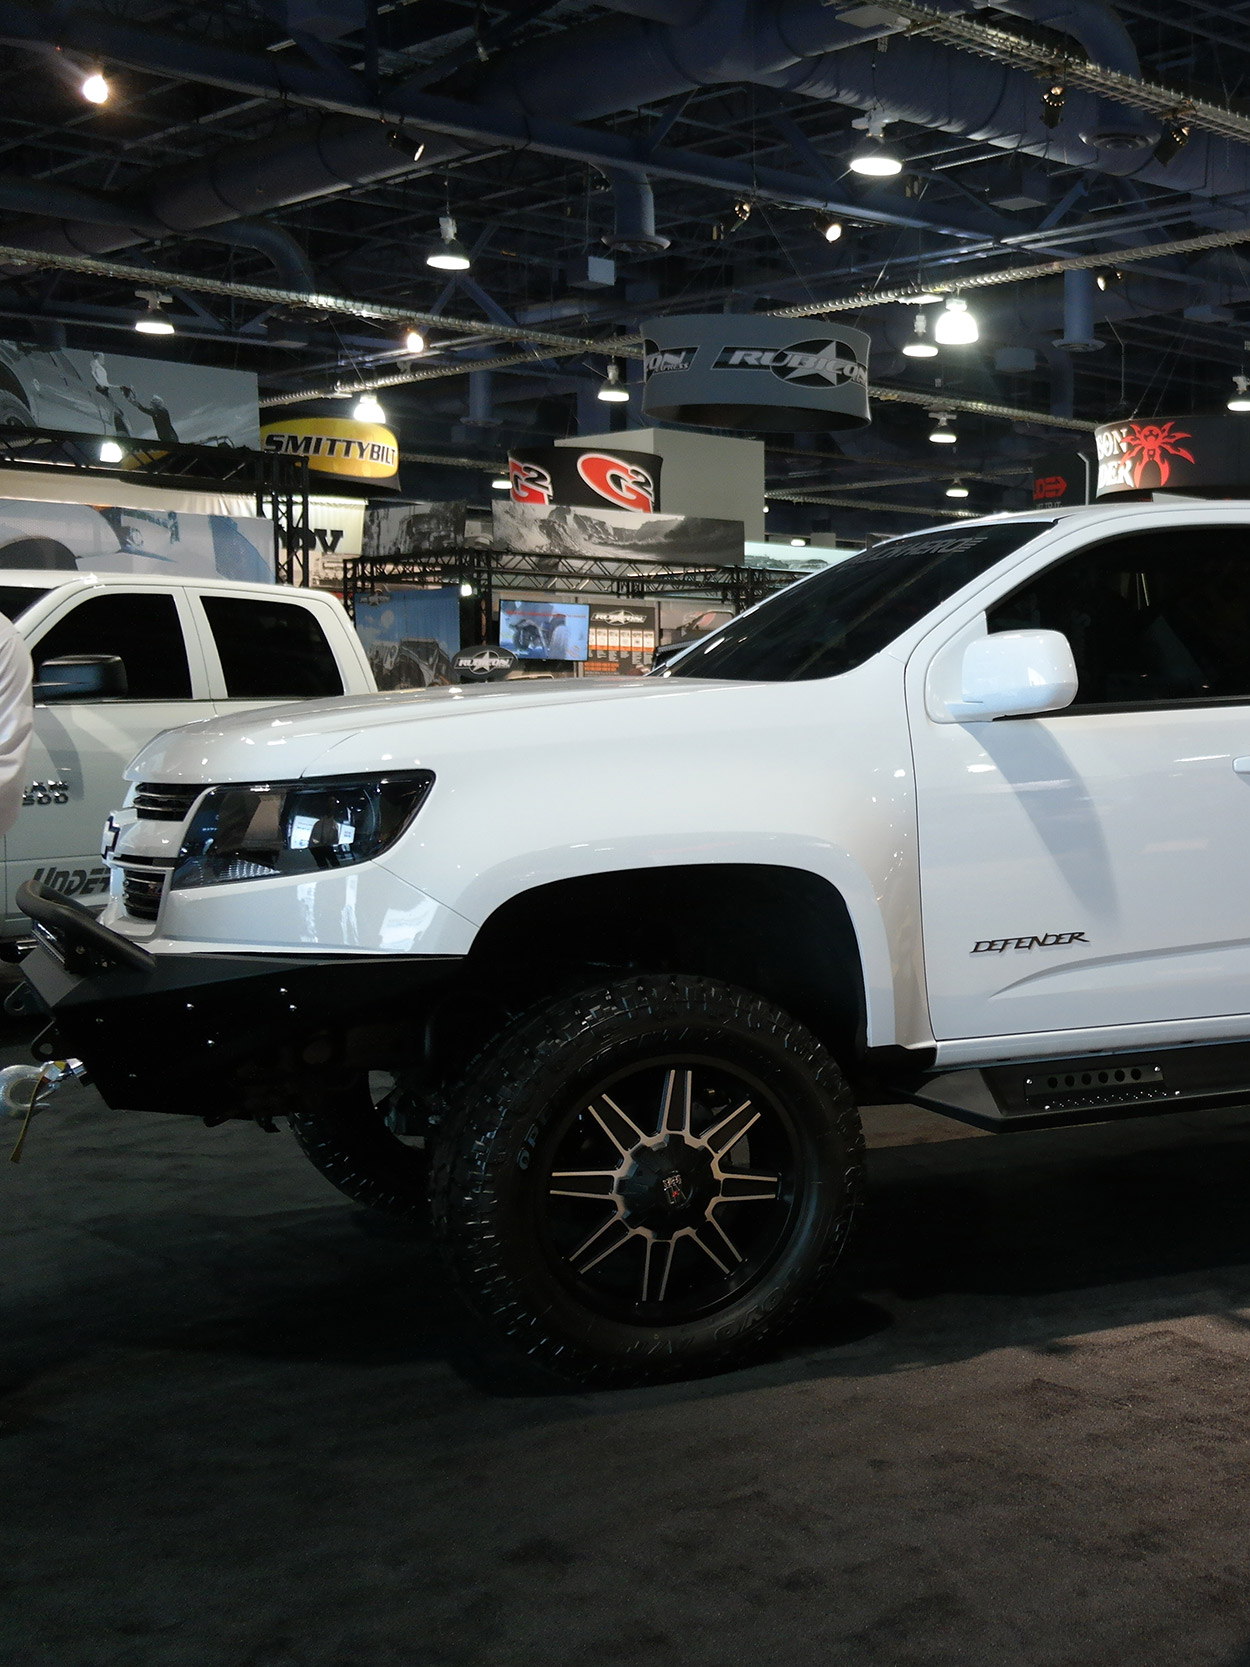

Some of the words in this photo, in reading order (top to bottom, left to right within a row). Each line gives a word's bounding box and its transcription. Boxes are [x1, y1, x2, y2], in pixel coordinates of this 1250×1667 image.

[727, 350, 867, 384] RUBICON
[263, 434, 397, 467] SMITTYBILT
[22, 791, 69, 806] 500
[970, 932, 1090, 954] DEFENDER
